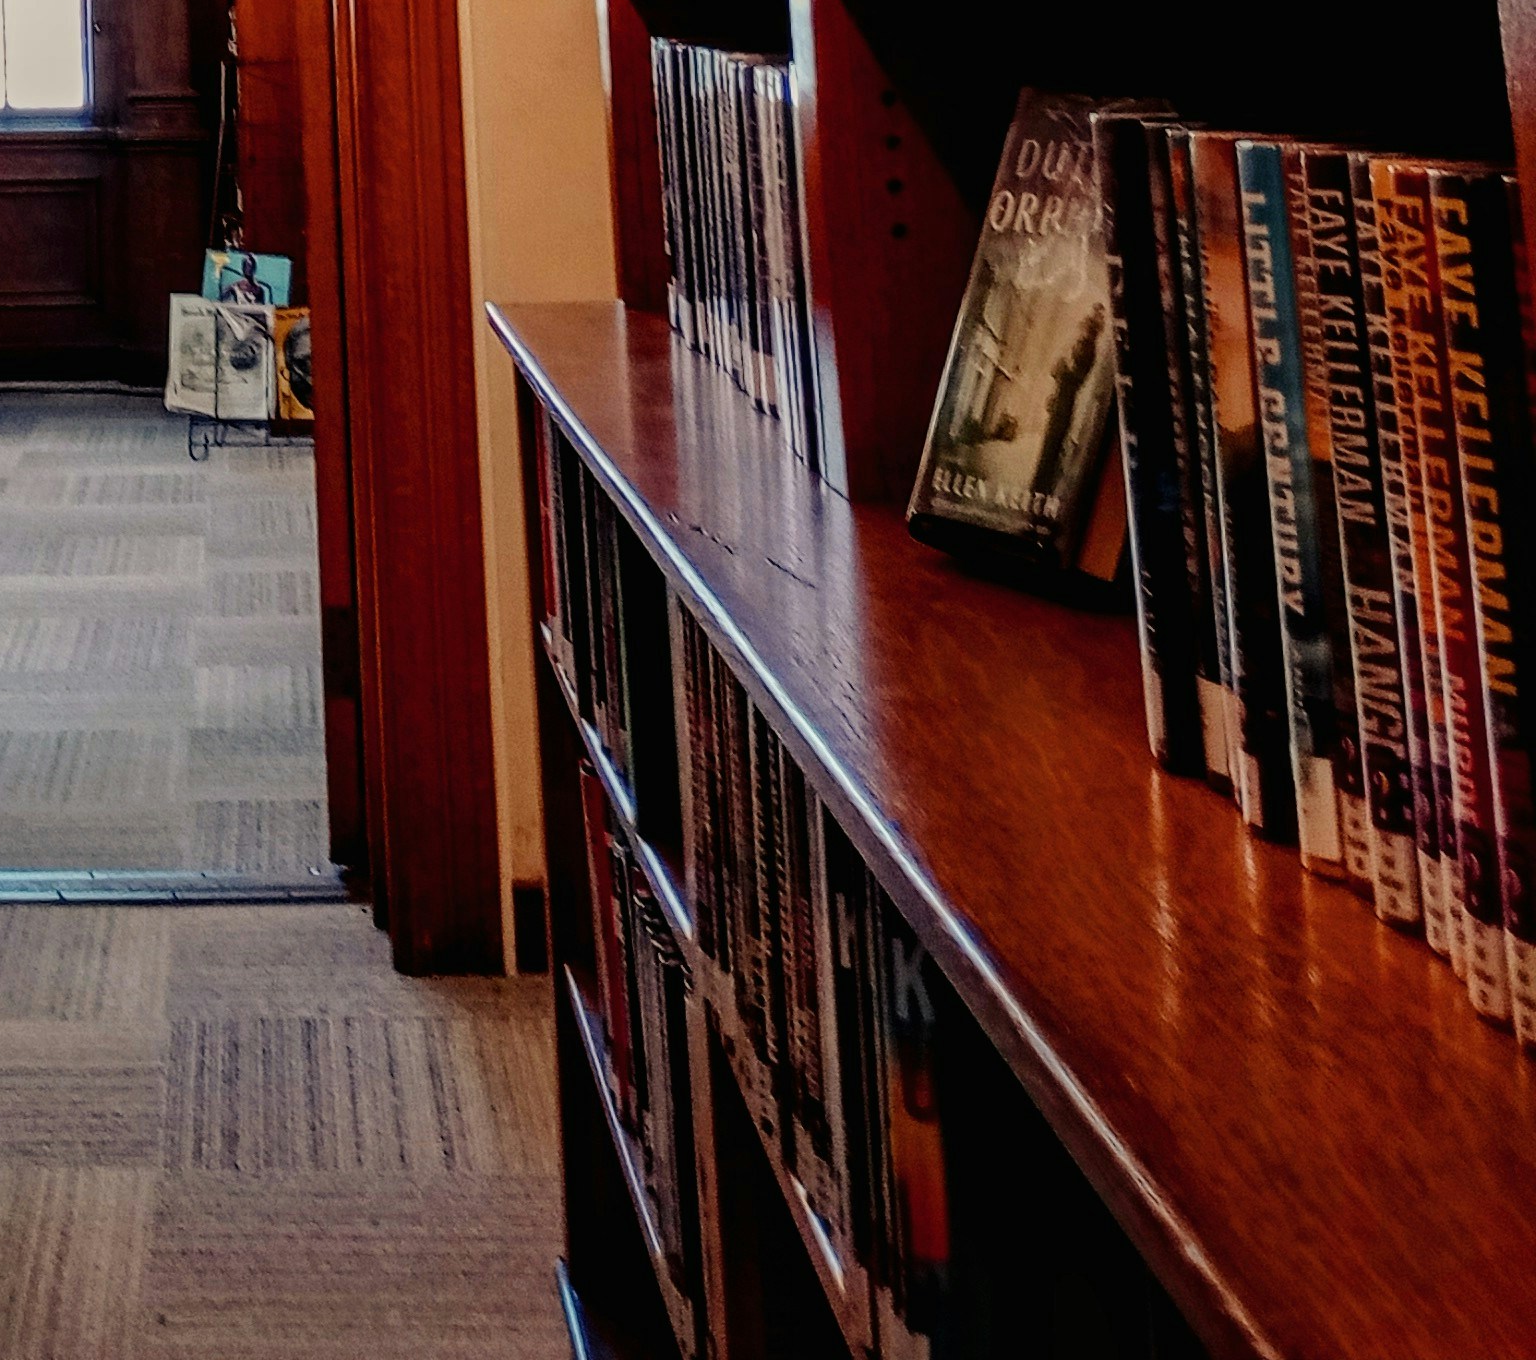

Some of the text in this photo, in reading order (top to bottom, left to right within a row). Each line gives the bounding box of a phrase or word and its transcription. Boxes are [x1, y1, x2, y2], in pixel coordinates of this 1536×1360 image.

[1241, 190, 1306, 618] LITTLE CENTURY
[1306, 187, 1377, 528] FAYE KELLERMAN
[1393, 194, 1468, 643] FAYE KELLERMAN
[1431, 195, 1519, 699] FAYE KELLERMAN
